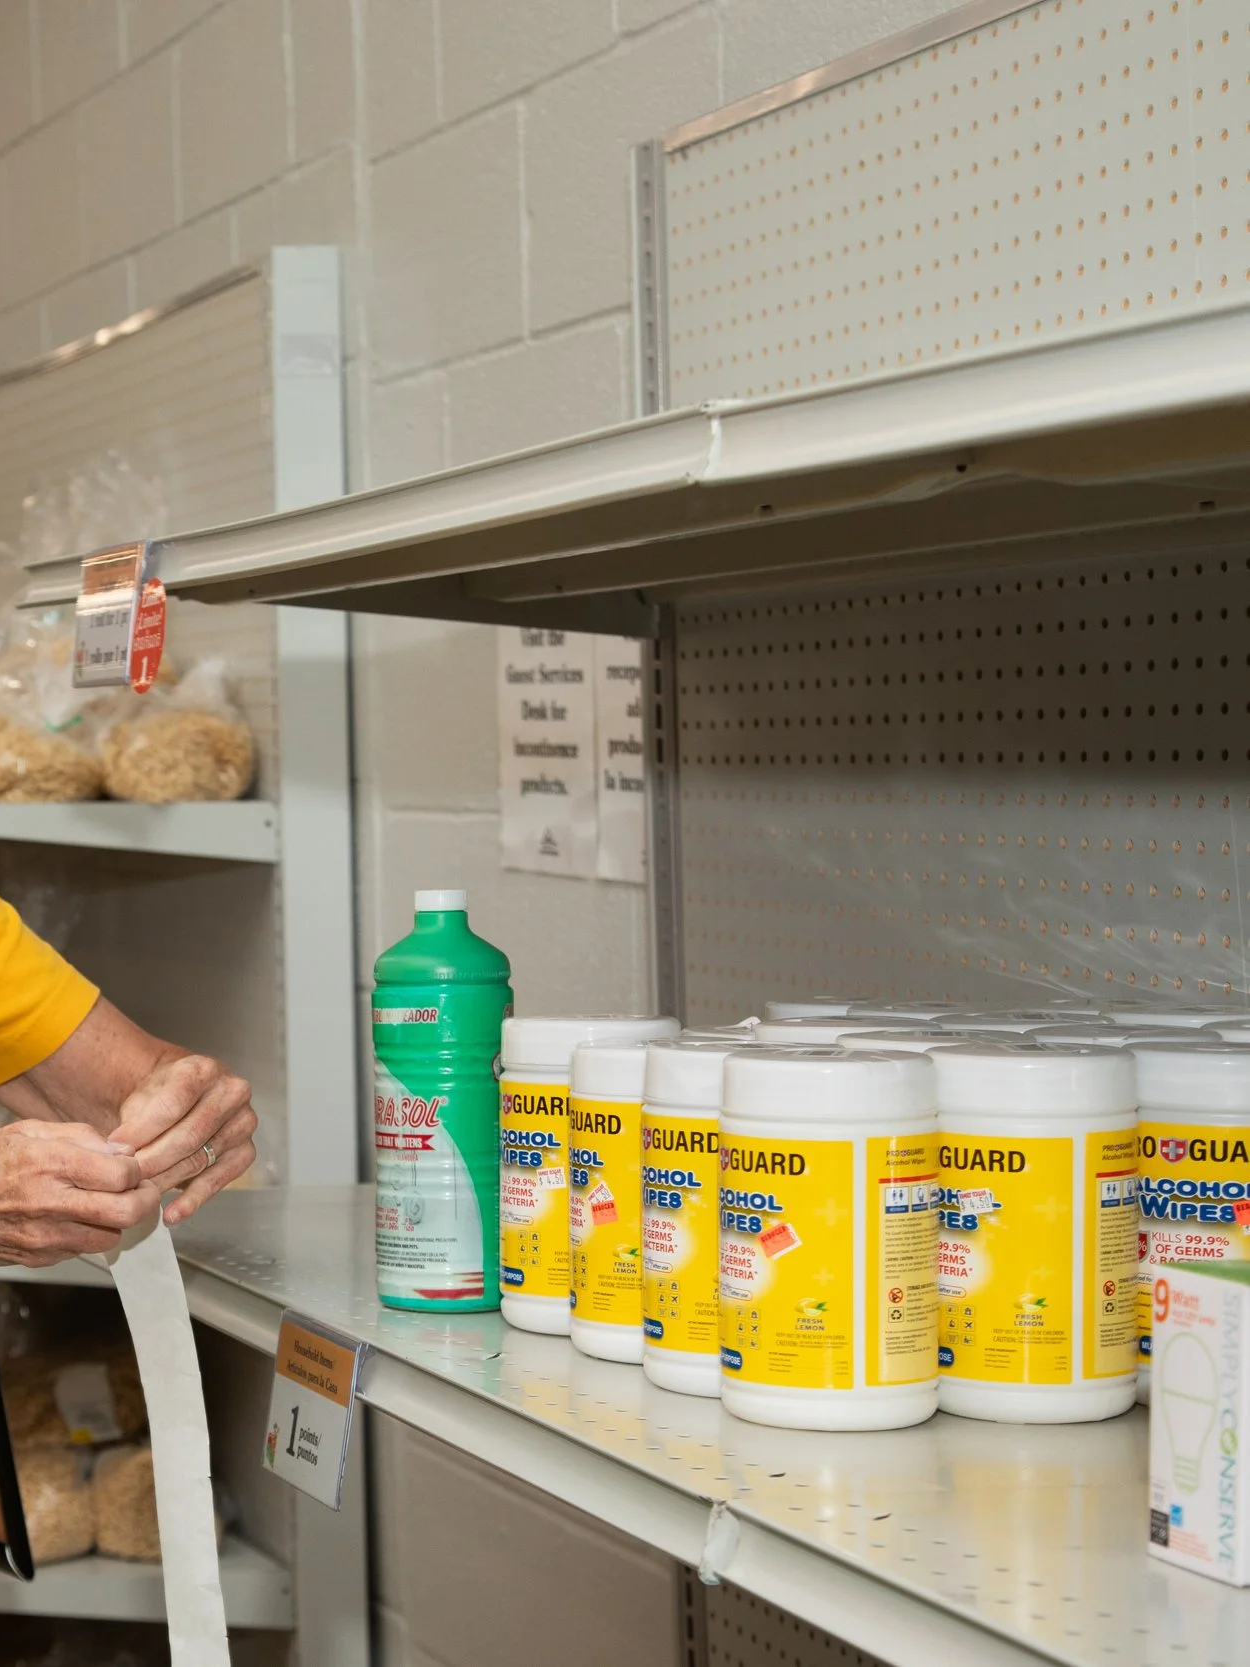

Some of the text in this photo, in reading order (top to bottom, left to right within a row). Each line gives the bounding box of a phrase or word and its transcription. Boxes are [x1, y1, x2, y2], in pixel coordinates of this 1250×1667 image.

[501, 1145, 543, 1167] IPES
[730, 1148, 806, 1176] GUARD
[939, 1145, 1026, 1173] GUARD
[507, 1187, 533, 1197] GERMS
[512, 1177, 537, 1187] 99.9%
[643, 1184, 682, 1208] IPES
[651, 1220, 676, 1231] 99.9%
[720, 1206, 762, 1234] IPES
[647, 1229, 672, 1241] GERMS
[1152, 1232, 1230, 1247] KILLS 99.9%
[729, 1244, 756, 1257] 99.9%
[1155, 1244, 1224, 1258] OF GERMS
[724, 1254, 752, 1268] GERMS
[1154, 1277, 1171, 1323] 9
[294, 1339, 320, 1365] Household
[325, 1377, 338, 1395] Casa
[285, 1405, 299, 1458] 1
[296, 1444, 318, 1466] puntos
